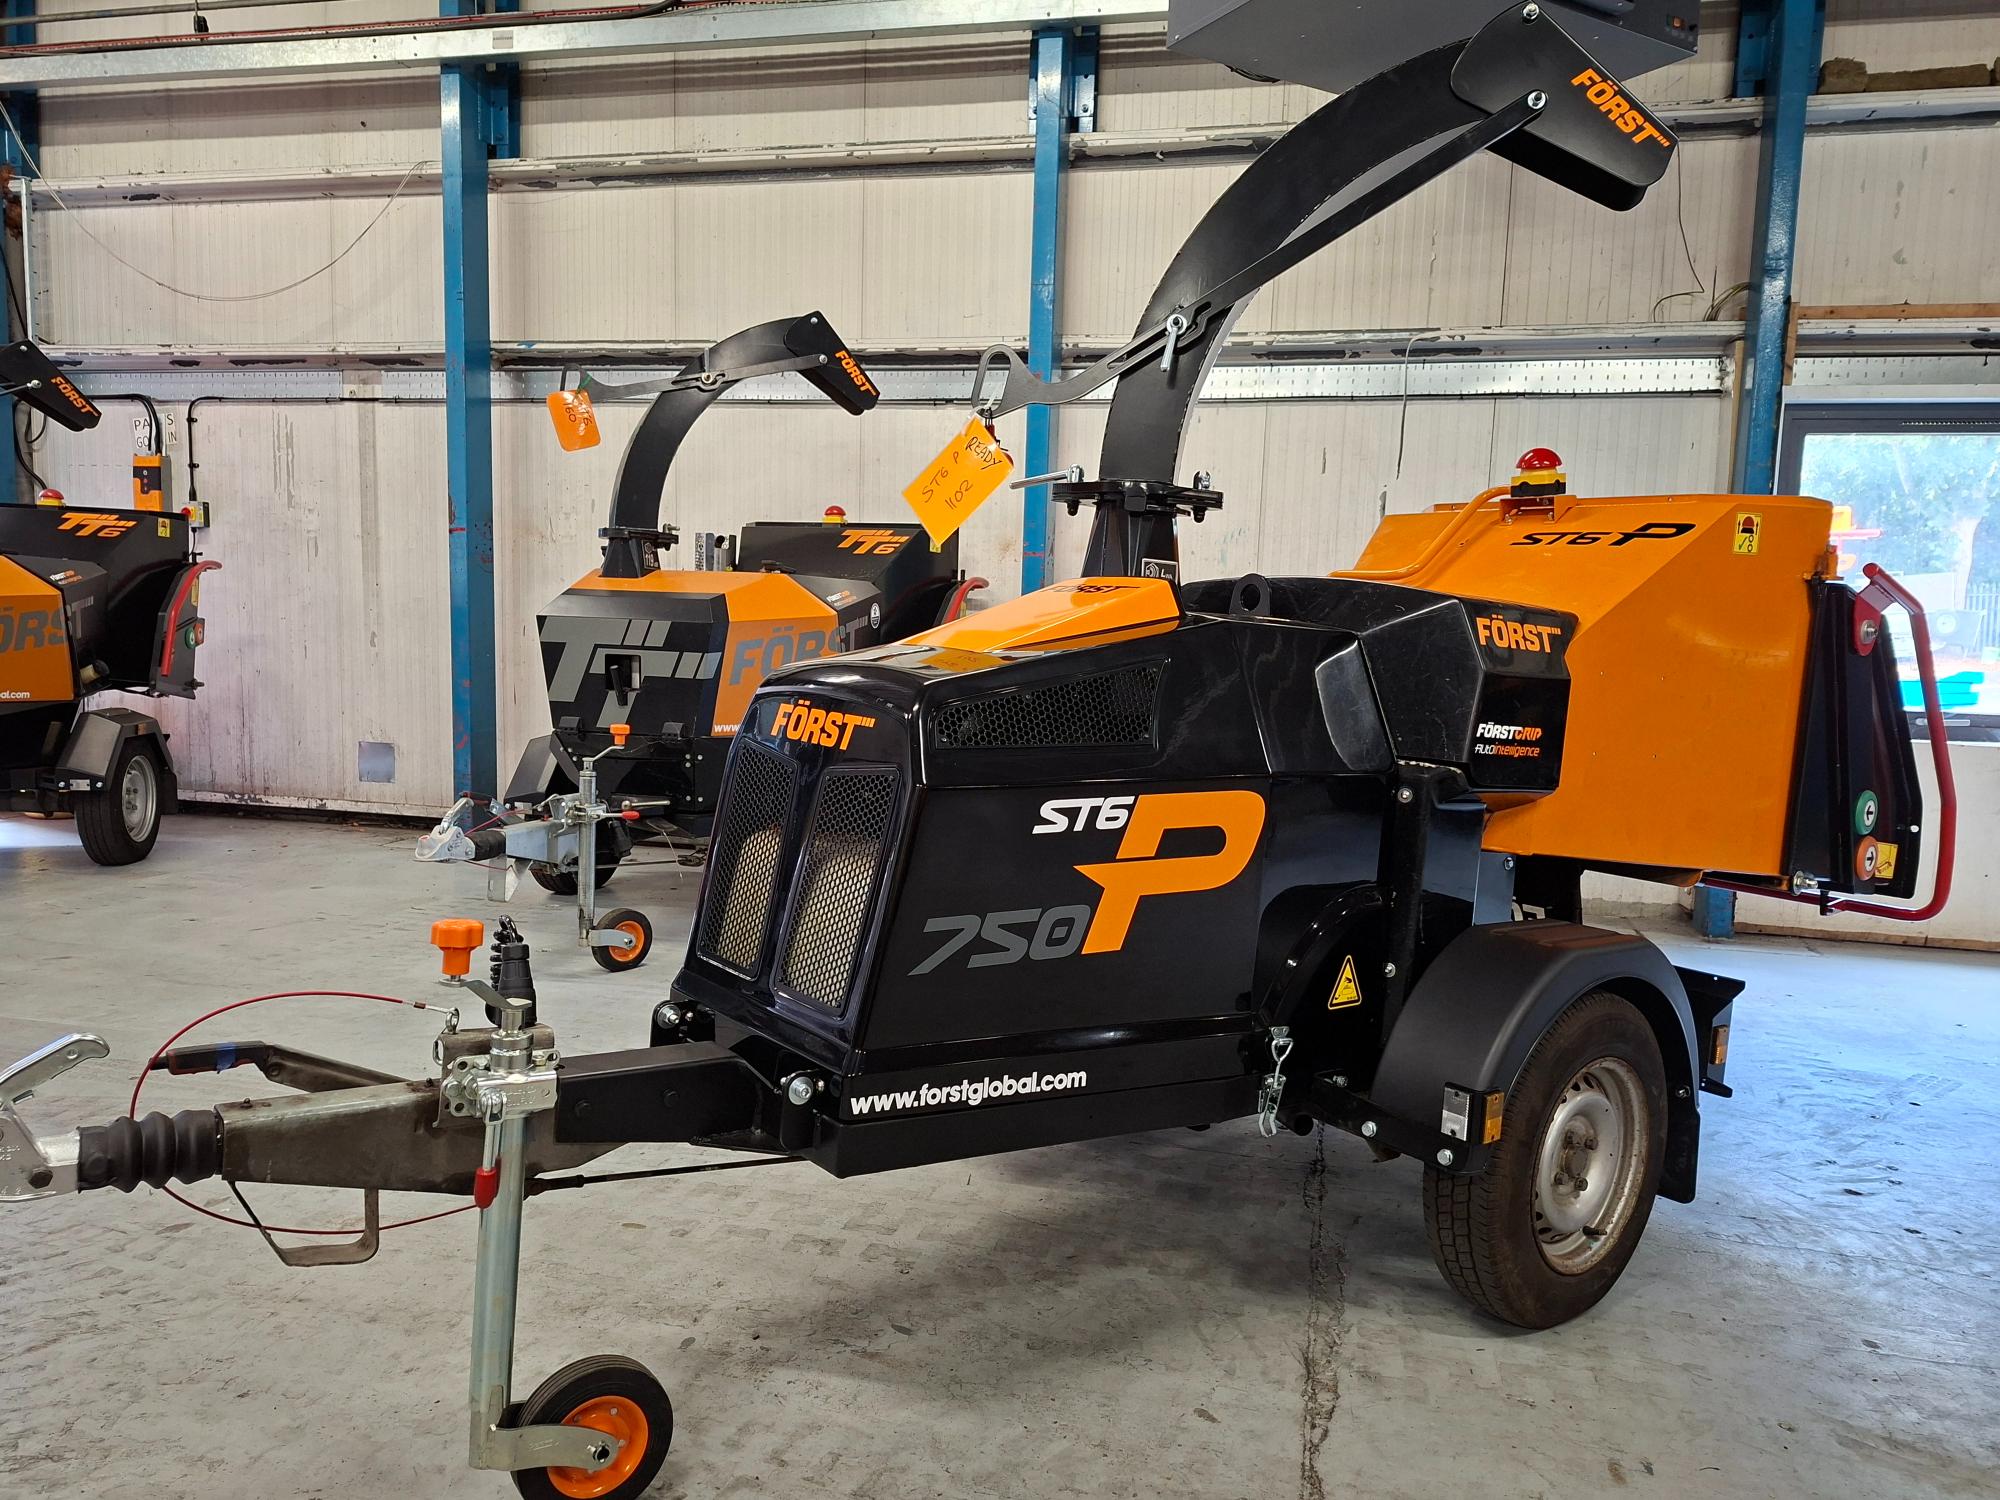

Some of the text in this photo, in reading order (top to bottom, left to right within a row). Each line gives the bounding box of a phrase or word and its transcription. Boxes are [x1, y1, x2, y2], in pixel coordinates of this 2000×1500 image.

[1571, 68, 1671, 148] FÖRST
[835, 350, 876, 396] FÖRST
[50, 376, 99, 416] FÖRST
[965, 436, 1003, 470] READY
[921, 467, 949, 503] ST6
[944, 479, 974, 509] 1102
[57, 512, 138, 537] TT6
[837, 529, 911, 554] TT6
[1510, 523, 1697, 546] ST6 P
[1476, 614, 1562, 653] FÖRST
[771, 699, 876, 751] FÖRST
[1032, 790, 1266, 955] ST6 P
[907, 904, 1091, 976] 750
[850, 1071, 1087, 1115] www.forstglobal.com
